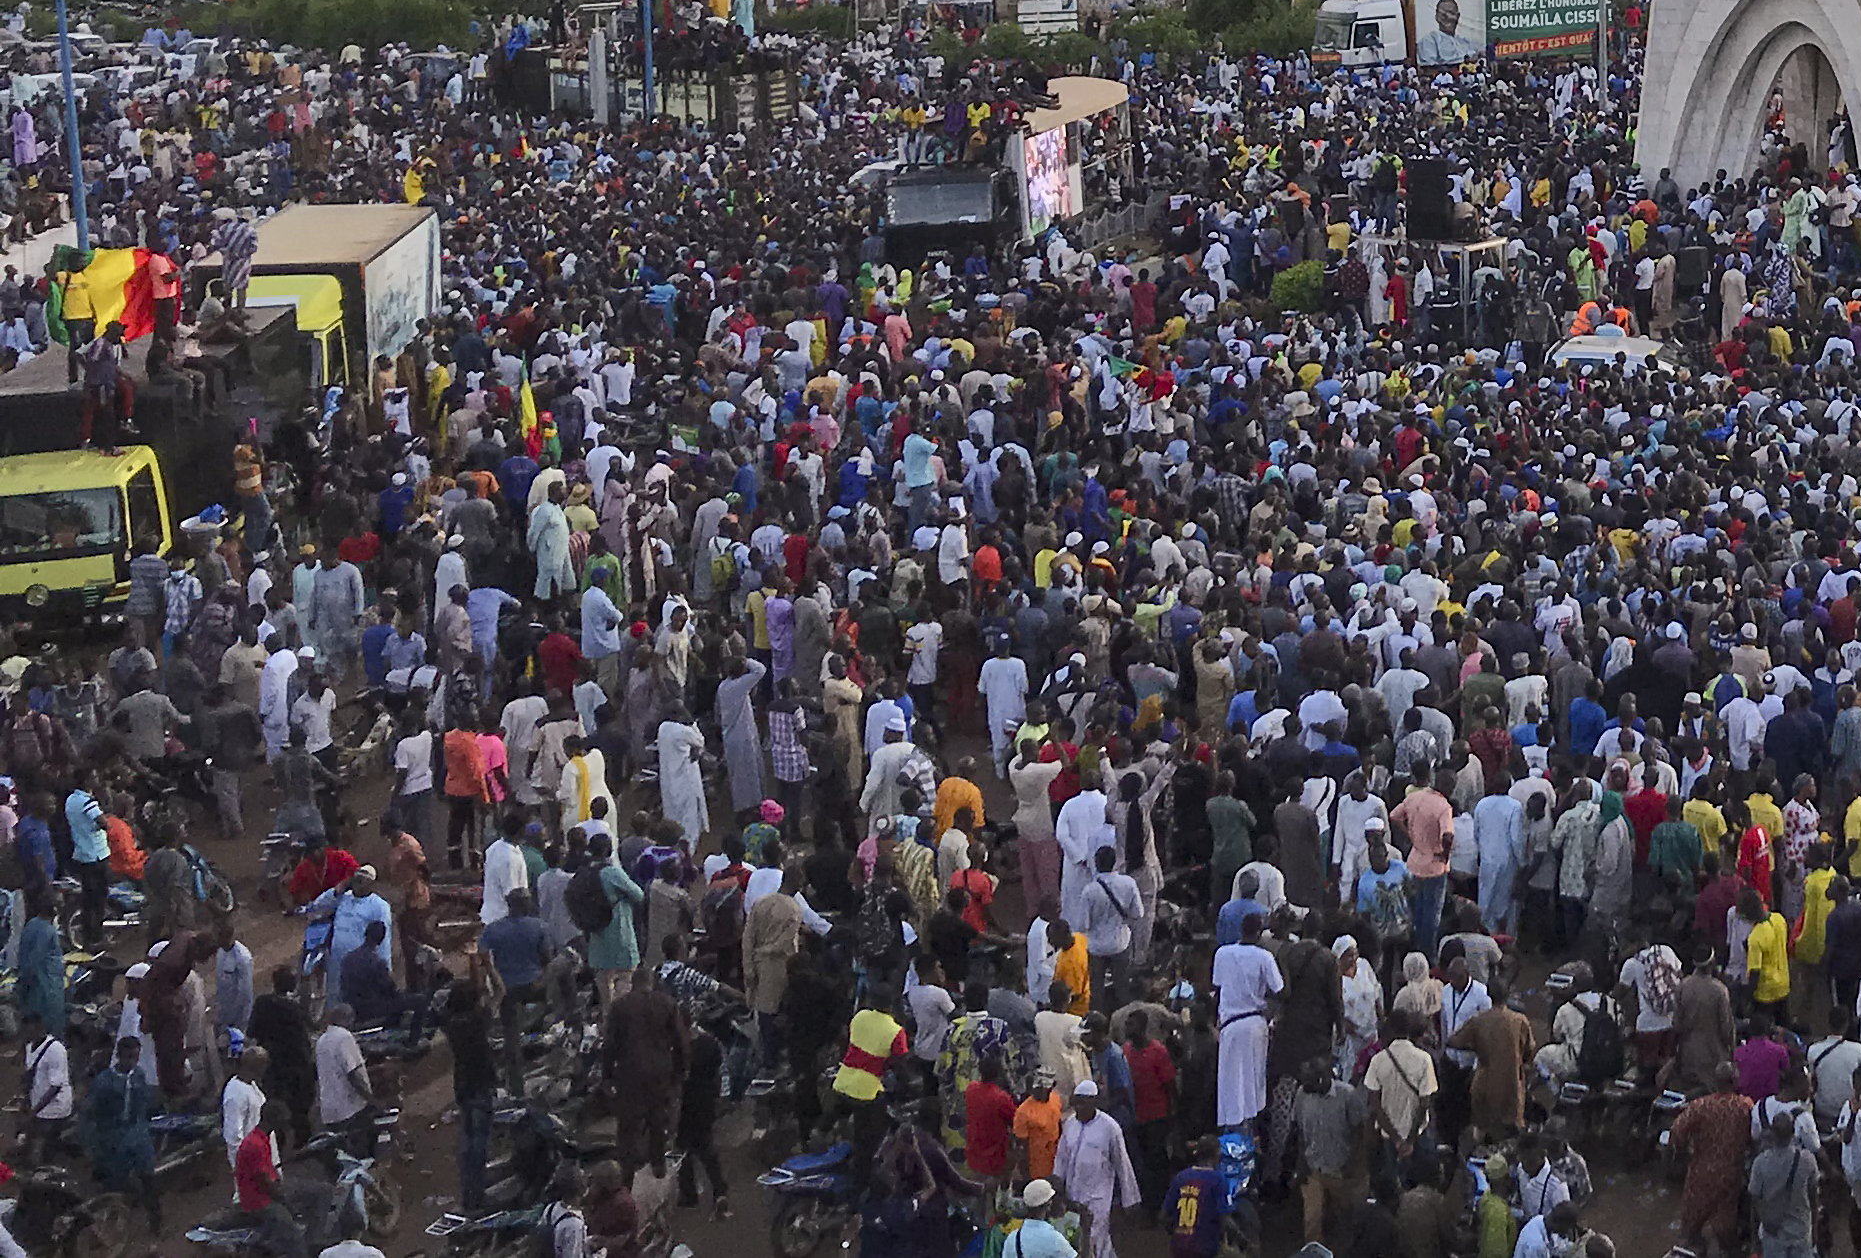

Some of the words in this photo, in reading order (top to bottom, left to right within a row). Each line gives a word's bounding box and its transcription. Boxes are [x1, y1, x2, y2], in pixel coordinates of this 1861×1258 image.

[1491, 10, 1563, 29] SOUMAÏLA
[1565, 10, 1600, 25] CISS
[1495, 41, 1537, 55] IENTÔT
[1177, 1197, 1198, 1227] 10
